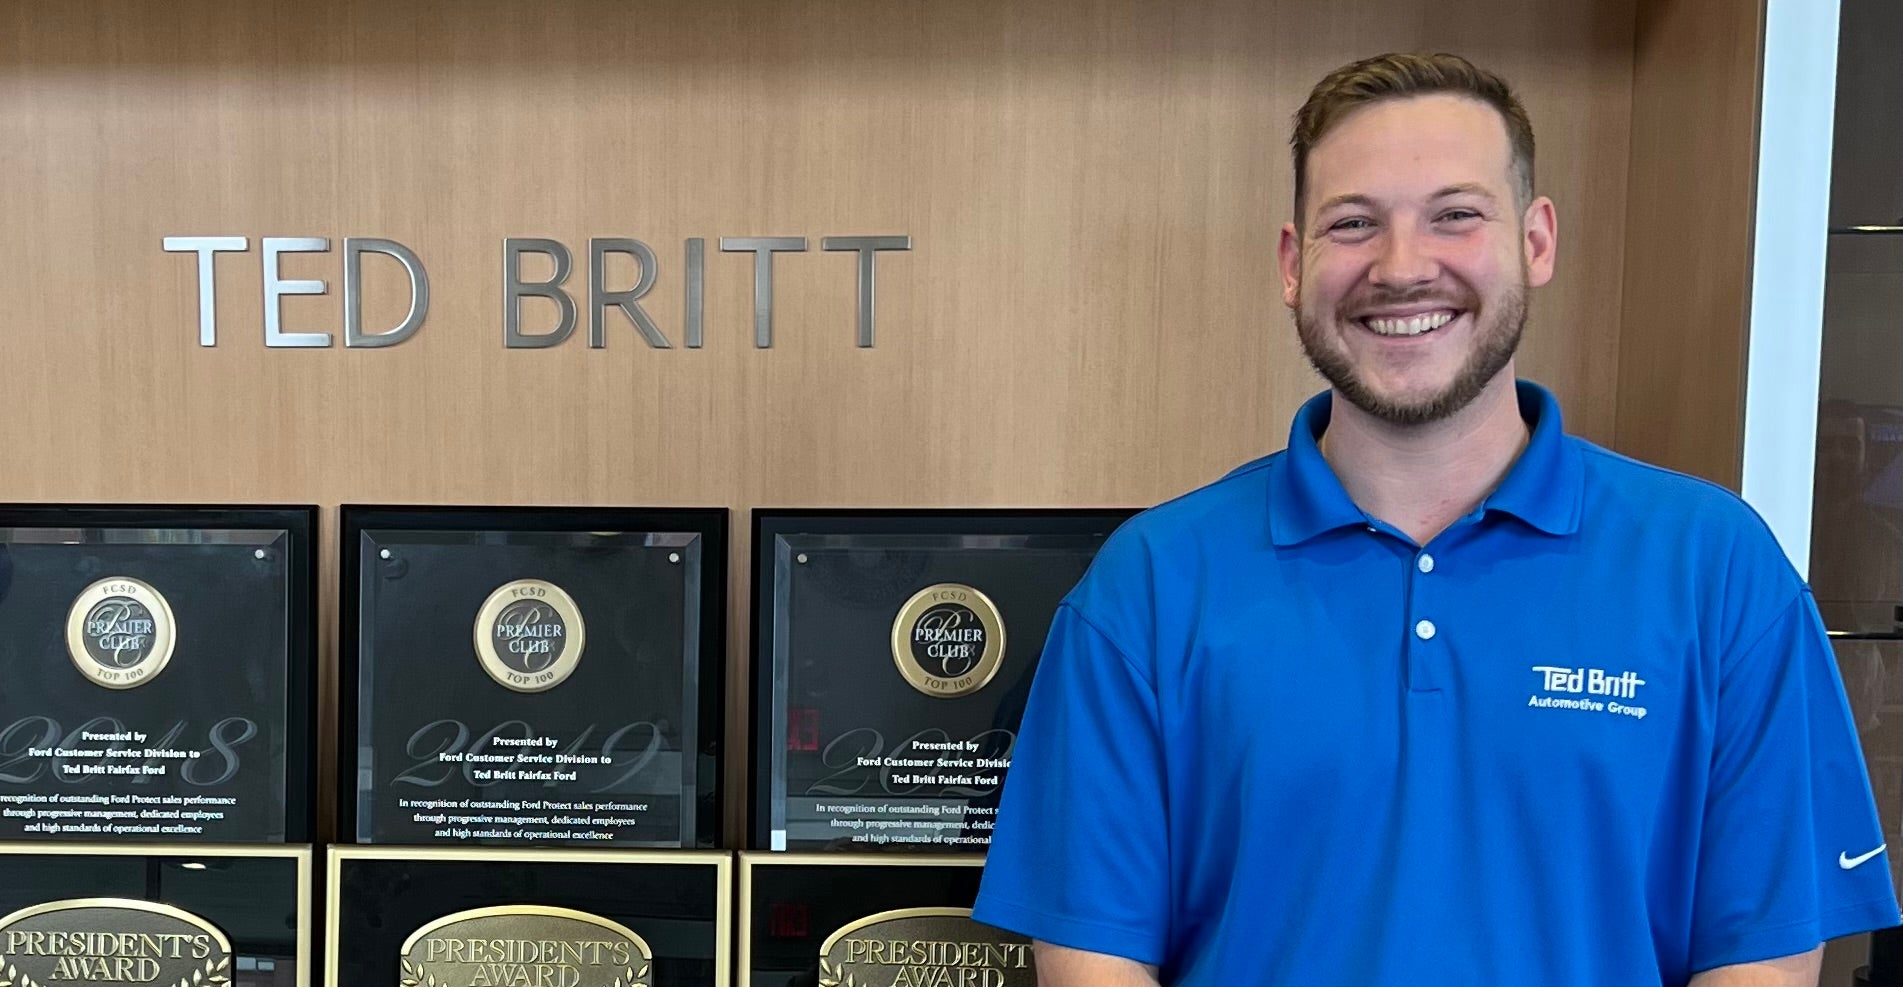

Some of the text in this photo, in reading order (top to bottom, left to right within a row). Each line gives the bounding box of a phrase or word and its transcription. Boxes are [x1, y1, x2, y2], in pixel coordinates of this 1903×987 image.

[162, 236, 912, 349] TED BRITT
[103, 584, 137, 595] FCSD
[512, 587, 546, 598] FCSD
[932, 591, 967, 602] FCSD
[87, 620, 152, 634] PREMIER
[497, 624, 562, 638] PREMIER
[915, 628, 982, 642] PREMIER
[100, 636, 140, 650] CLUB
[509, 640, 549, 653] CLUB
[928, 644, 968, 658] CLUB
[96, 668, 144, 681] TOP 100
[506, 671, 555, 685] TOP 100
[924, 676, 972, 690] TOP 100
[1532, 666, 1646, 698] Ted Britt
[1528, 695, 1647, 719] Automotive Group
[82, 732, 147, 743] Presented by
[493, 737, 557, 748] Presented by
[912, 741, 979, 752] Presented by
[29, 748, 200, 759] Ford Customer Service Division to
[439, 753, 611, 764] Ford Customer Service Division to
[805, 728, 1017, 797] 202
[857, 757, 881, 766] Ford
[884, 758, 934, 767] Customer
[937, 758, 973, 767] Service
[63, 765, 165, 775] Ted Britt Fairfax Ford
[473, 770, 576, 780] Ted Britt Fairfax Ford
[892, 775, 998, 785] Ted Britt Fairfax Ford
[49, 794, 59, 803] of
[60, 794, 109, 805] outstanding
[111, 796, 130, 804] Ford
[132, 796, 160, 804] Protect
[163, 796, 182, 805] sales
[184, 796, 236, 807] performance
[399, 799, 647, 812] In recognition of outstanding Ford Protect sales performance
[3, 809, 223, 821] through progressive management, dedicated employees
[816, 804, 825, 812] In
[828, 805, 875, 814] recognition
[877, 805, 888, 813] of
[889, 805, 939, 815] outstanding
[941, 806, 961, 814] Ford
[963, 806, 993, 815] Protect
[414, 814, 635, 827] through progressive management, dedicated employees
[831, 819, 995, 830] through progressive management, dedic
[25, 824, 202, 835] and high standards of operational excellence
[435, 829, 613, 840] and high standards of operational excellence
[852, 834, 991, 845] and high standards of operational
[7, 931, 210, 959] PRESIDENT'S
[426, 939, 630, 965] PRESIDENT'S
[845, 939, 1033, 969] PRESIDENT
[49, 957, 160, 982] AWARD
